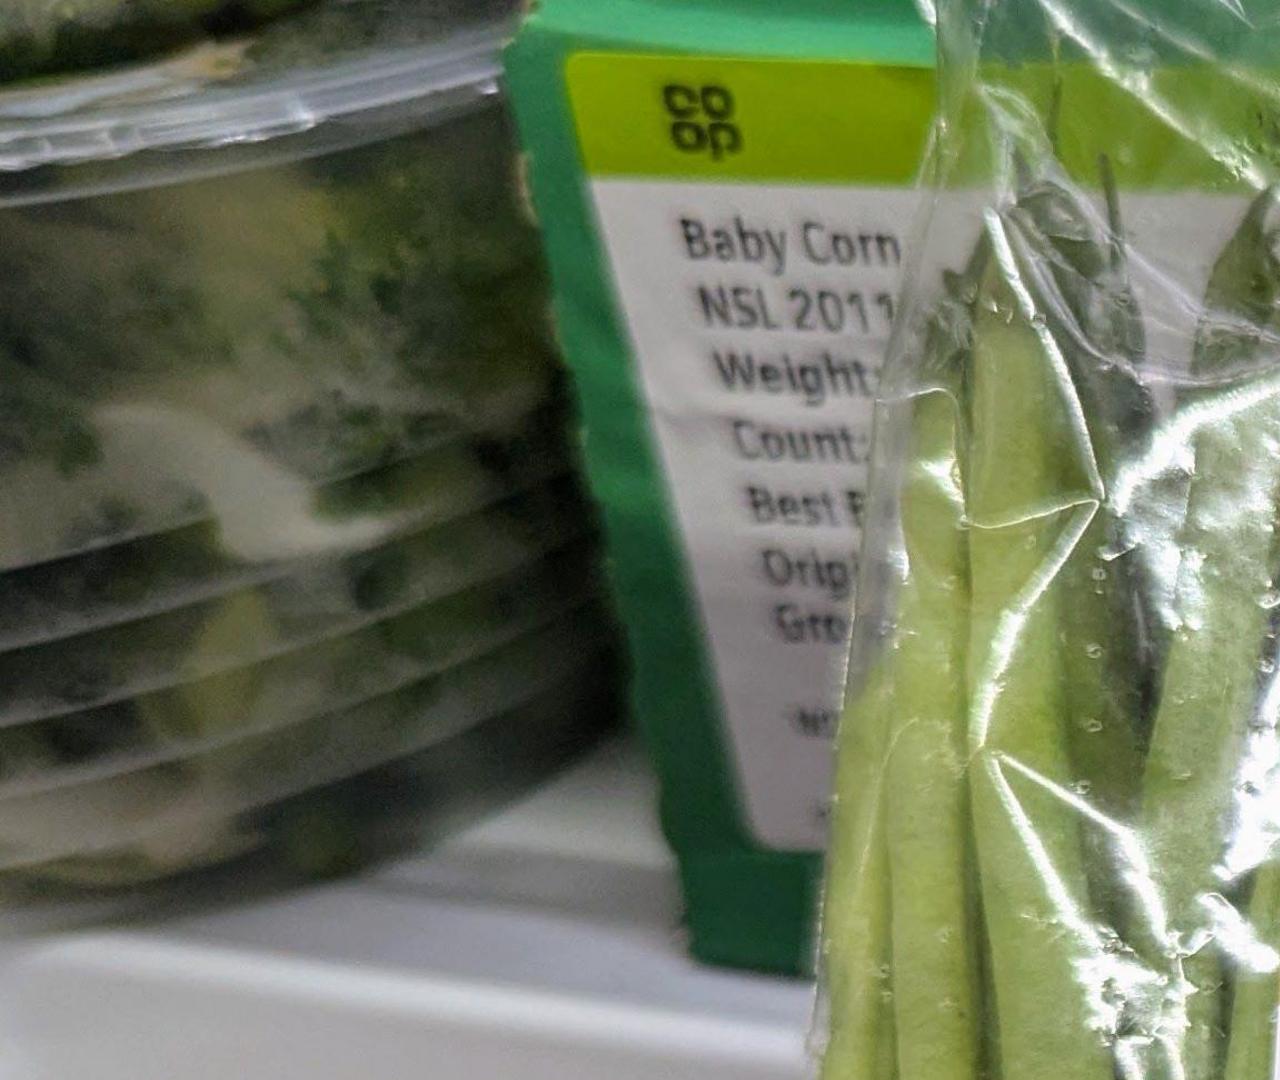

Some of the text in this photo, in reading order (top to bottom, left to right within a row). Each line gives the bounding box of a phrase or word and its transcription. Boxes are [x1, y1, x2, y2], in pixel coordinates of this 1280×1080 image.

[679, 216, 900, 277] Baby Corn
[698, 285, 896, 333] NSL 2011
[747, 486, 836, 526] Best
